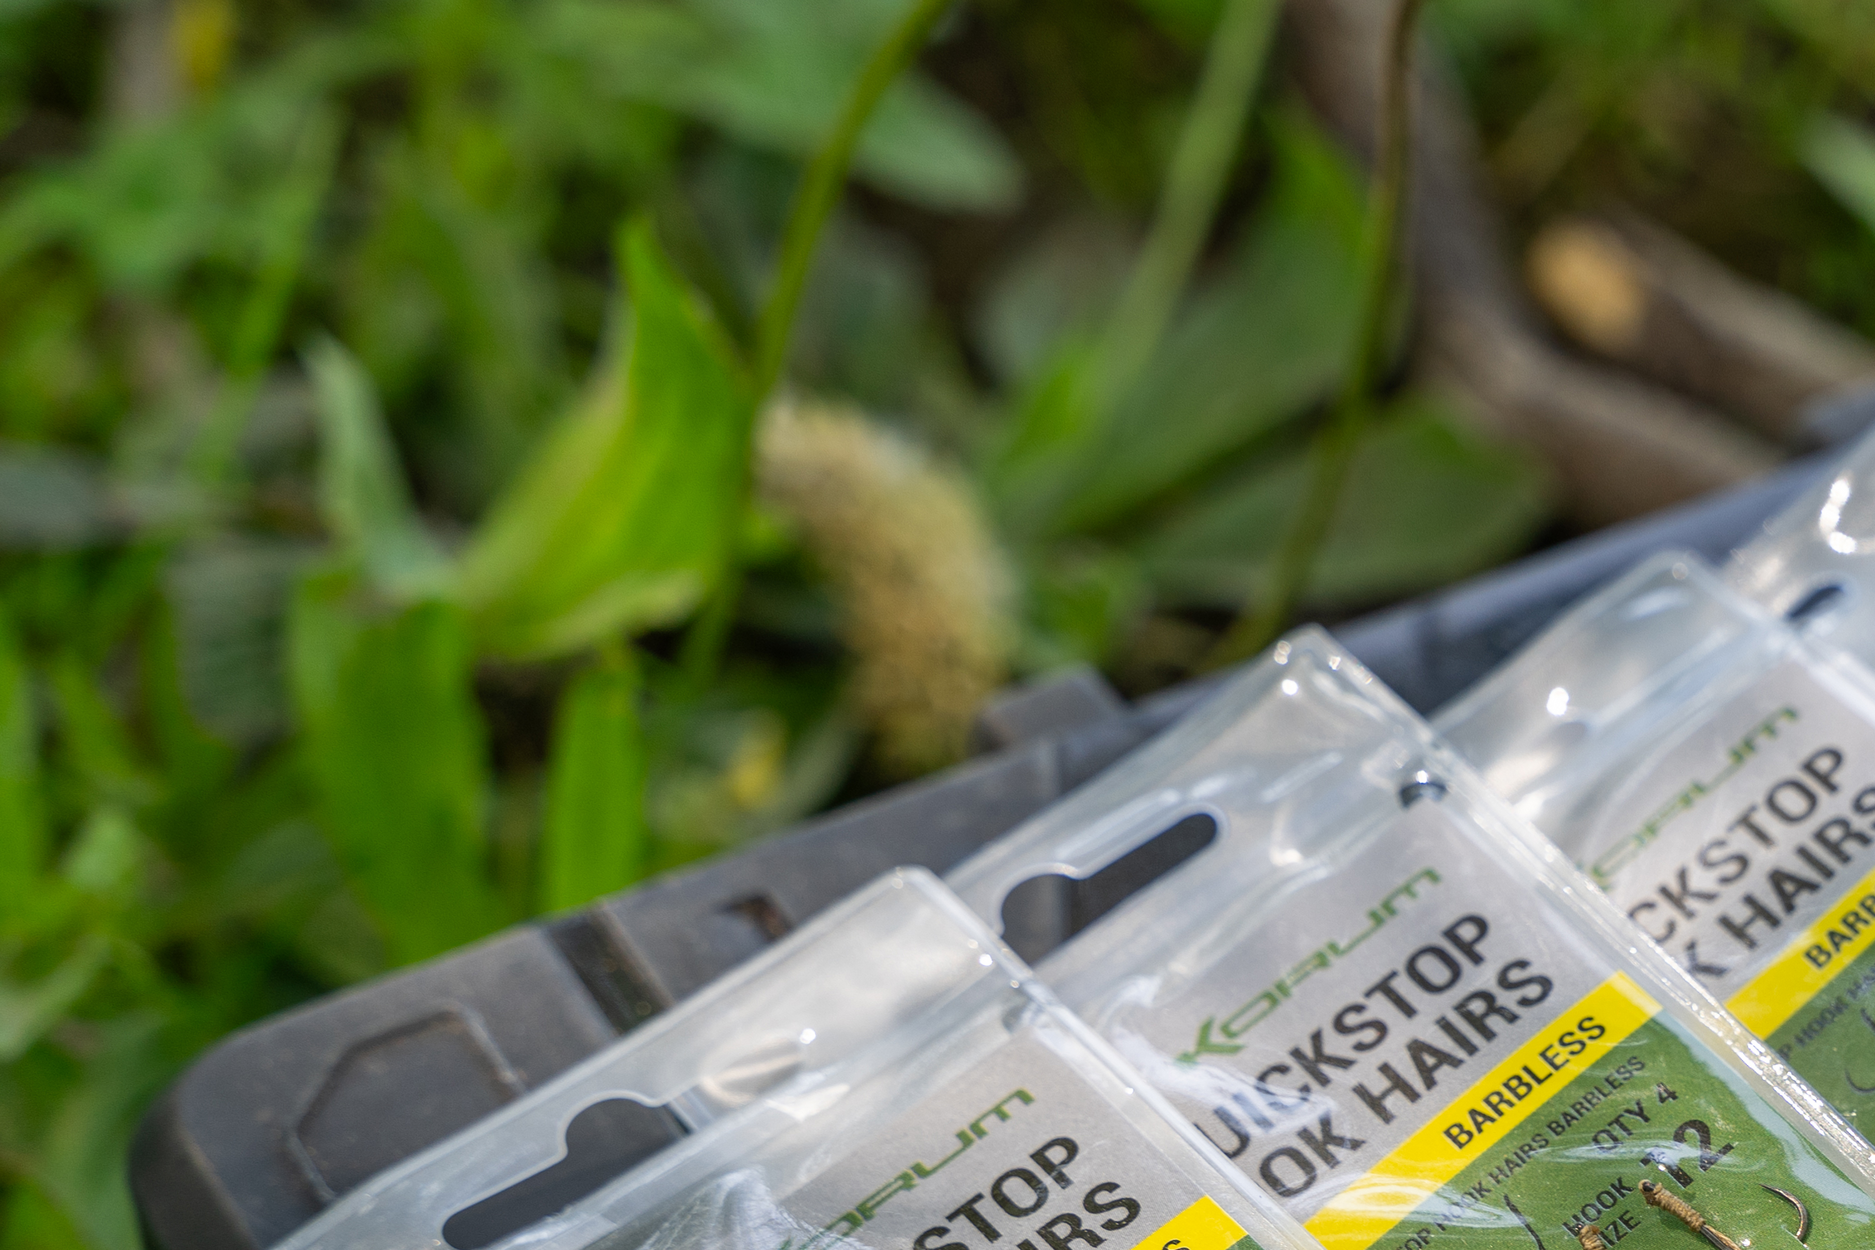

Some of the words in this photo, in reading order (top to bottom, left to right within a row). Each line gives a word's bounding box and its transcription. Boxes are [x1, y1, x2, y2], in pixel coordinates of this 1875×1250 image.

[1352, 956, 1554, 1126] HAIRS
[1443, 1014, 1606, 1151] BARBLESS
[1591, 1099, 1651, 1153] QTY
[1654, 1081, 1679, 1107] 4
[1487, 1132, 1550, 1187] HAIRS
[1546, 1055, 1646, 1138] BARBLESS
[1639, 1118, 1735, 1189] 12
[1562, 1176, 1635, 1238] HOOK
[1602, 1208, 1641, 1249] IZE
